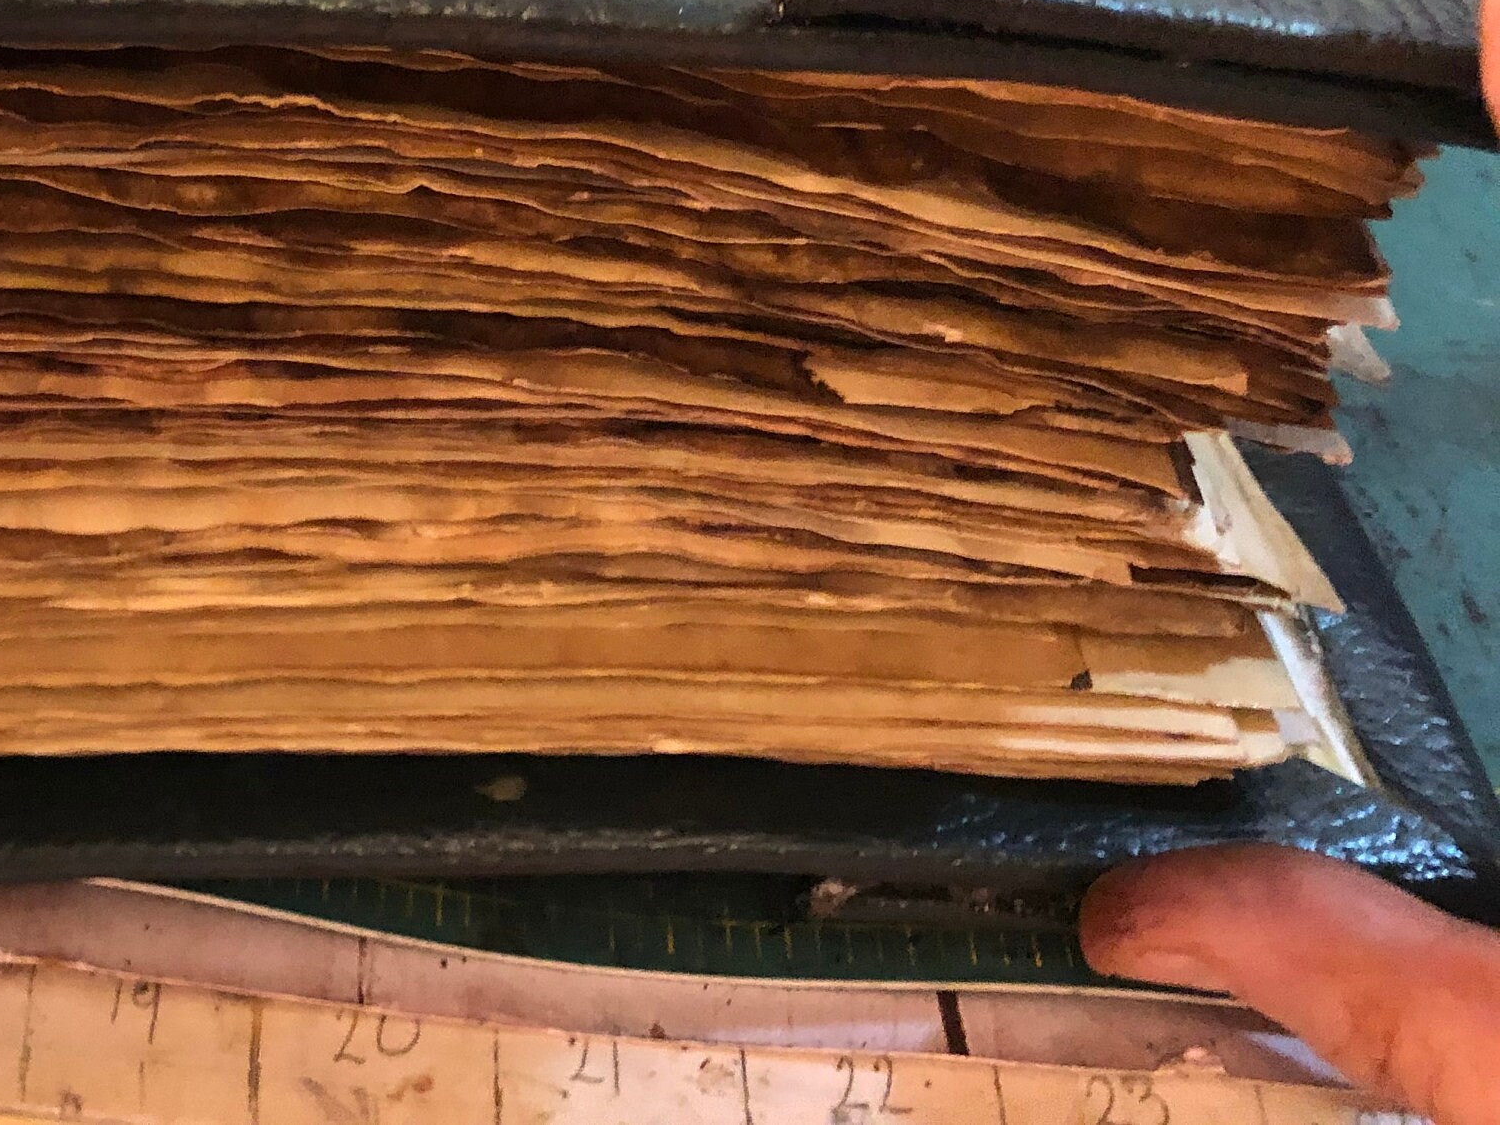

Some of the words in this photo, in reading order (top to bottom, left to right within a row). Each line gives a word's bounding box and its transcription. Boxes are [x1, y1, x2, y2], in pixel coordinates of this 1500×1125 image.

[110, 979, 162, 1044] 19
[333, 1008, 421, 1064] 20
[835, 1055, 913, 1114] 22
